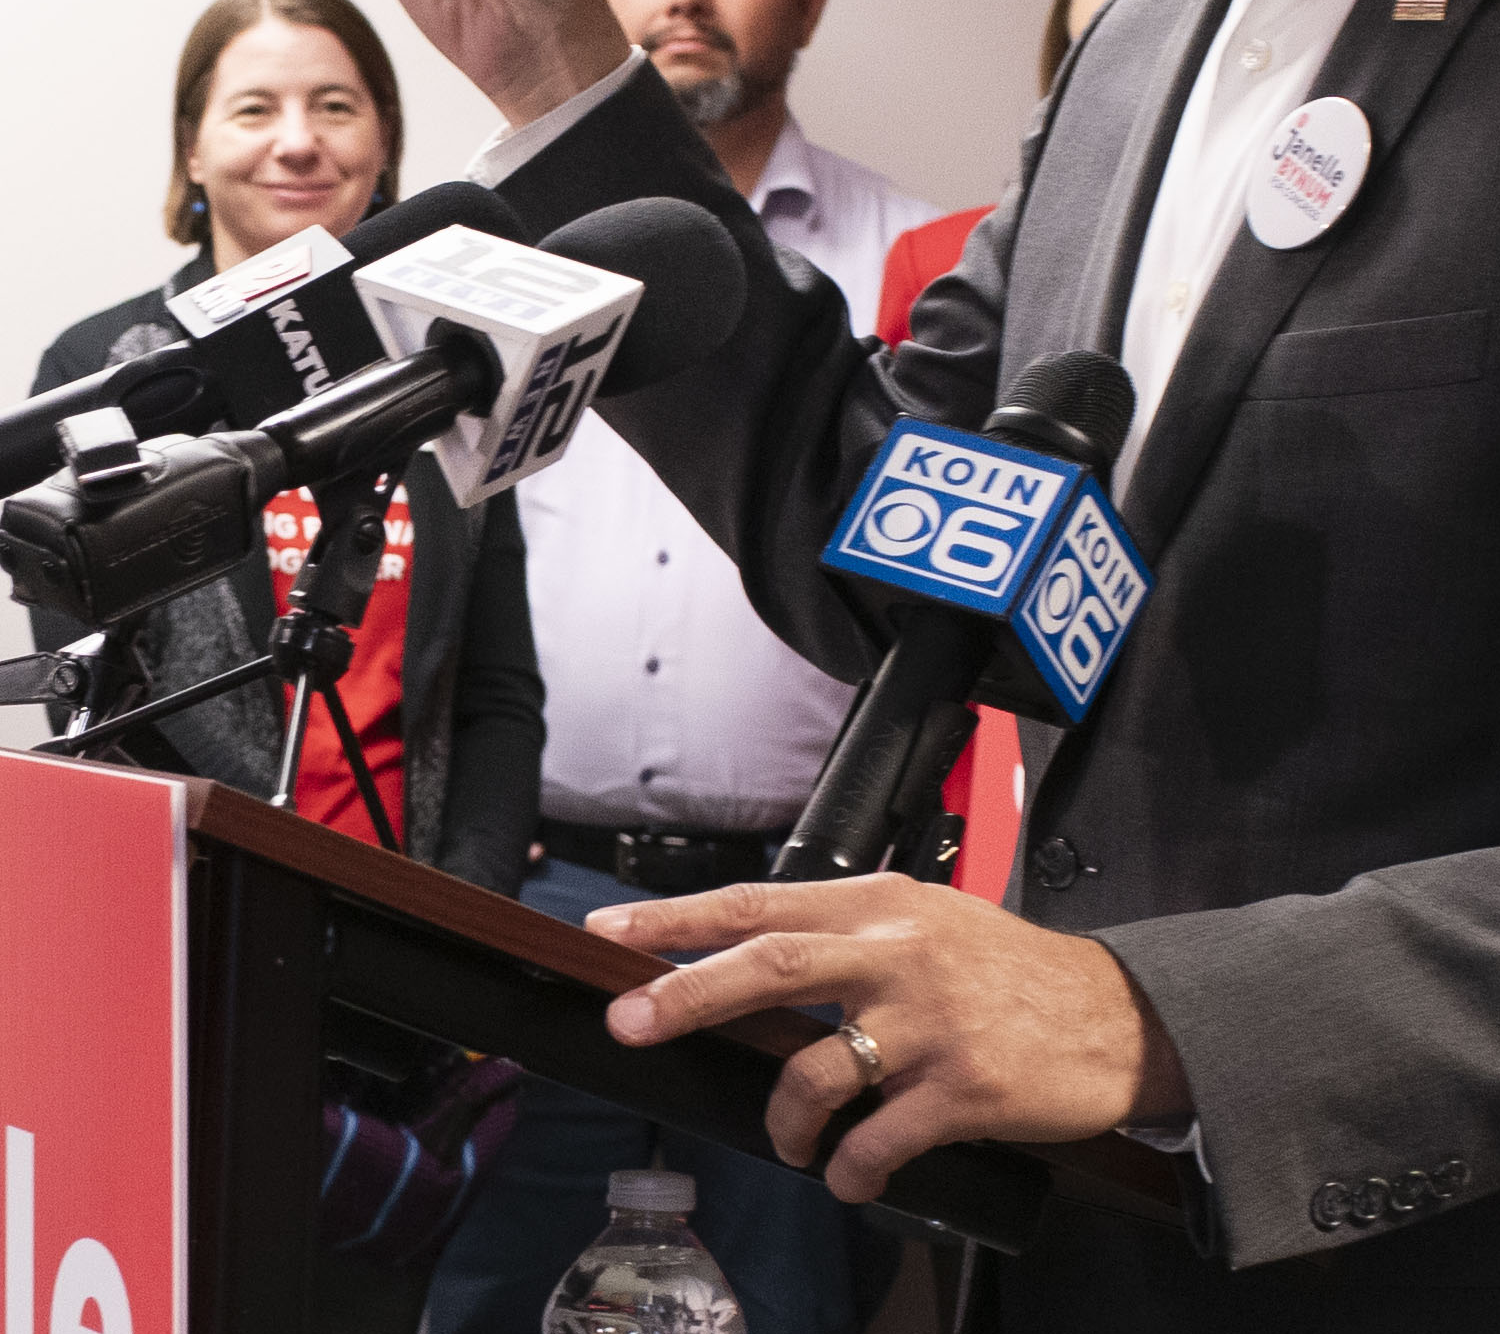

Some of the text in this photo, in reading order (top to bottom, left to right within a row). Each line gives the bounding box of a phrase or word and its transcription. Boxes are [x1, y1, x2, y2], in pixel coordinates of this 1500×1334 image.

[266, 298, 335, 396] KATU
[905, 446, 1044, 507] KOIN
[929, 506, 1023, 582] 6
[1075, 511, 1136, 612] KOIN
[1060, 596, 1113, 685] 6
